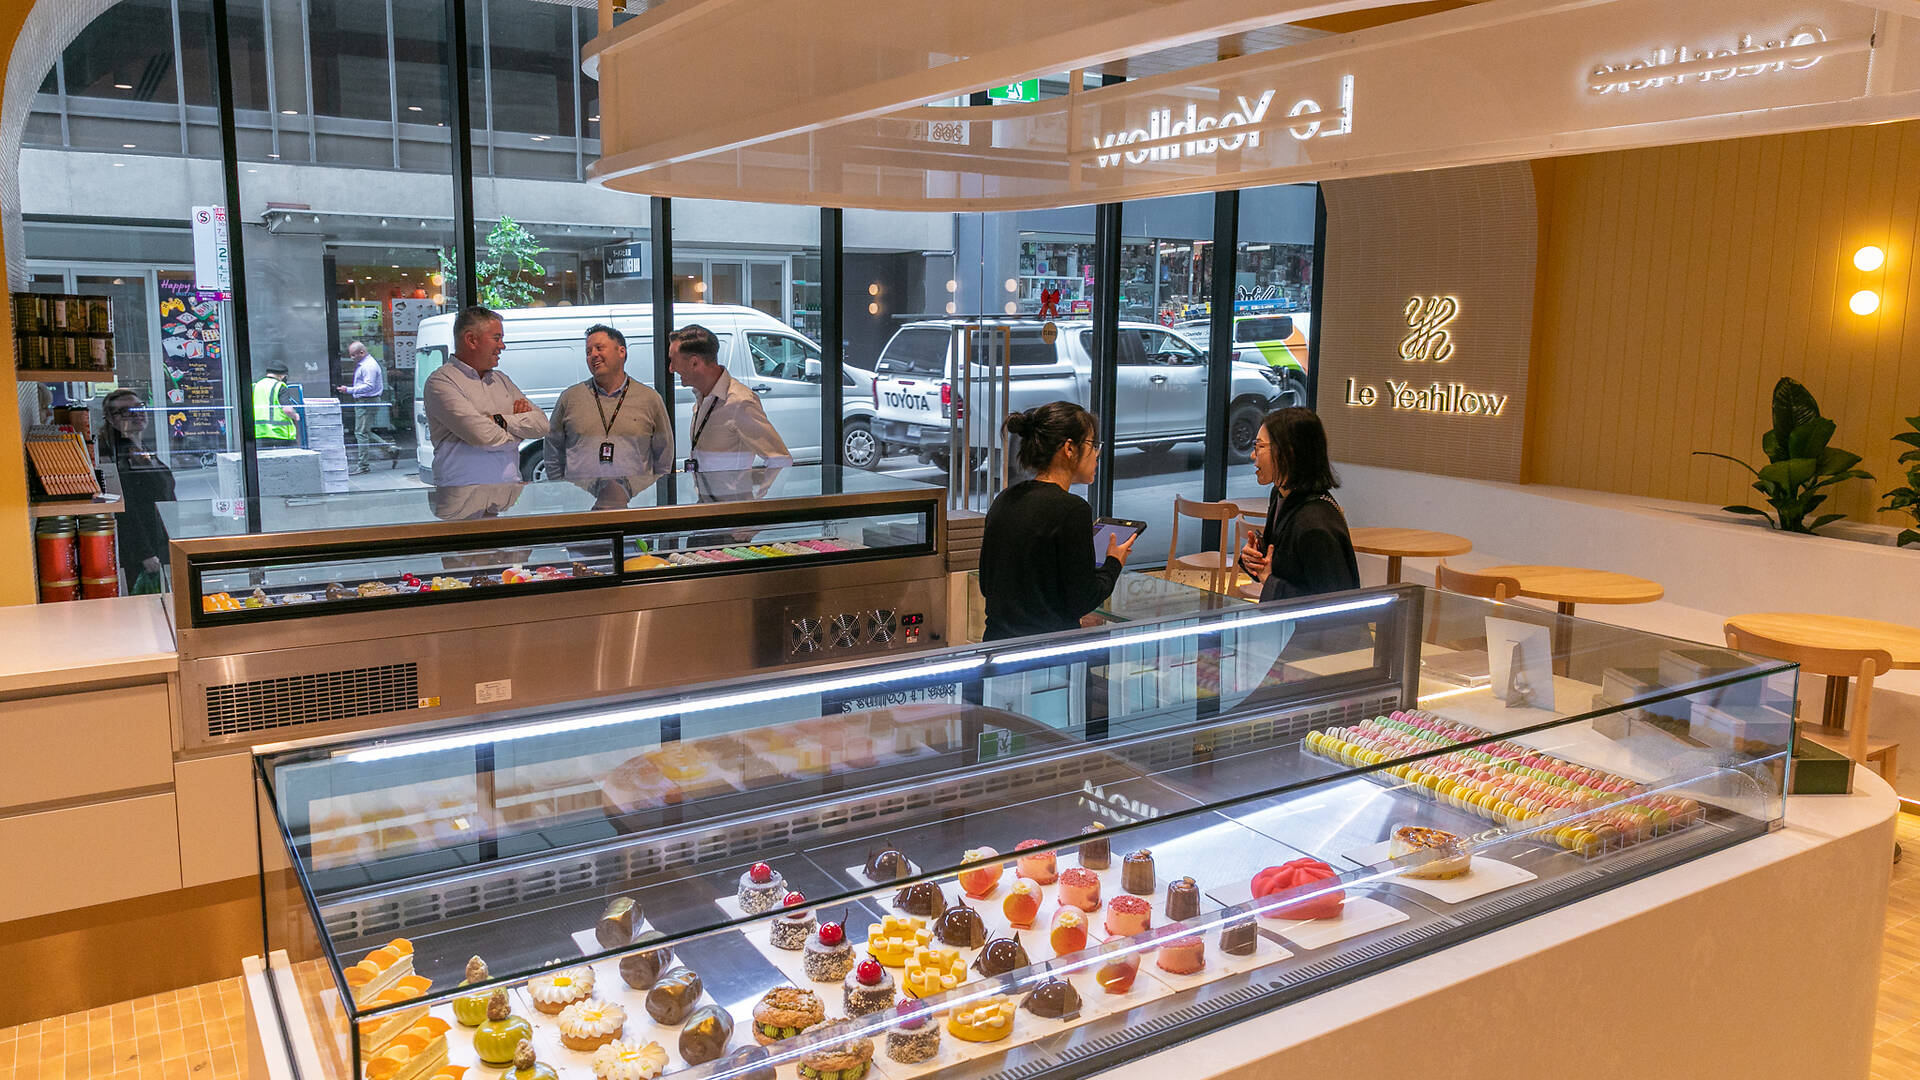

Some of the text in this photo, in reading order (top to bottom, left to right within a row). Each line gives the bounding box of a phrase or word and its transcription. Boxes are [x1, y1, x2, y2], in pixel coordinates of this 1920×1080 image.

[161, 279, 191, 294] Happy
[884, 391, 930, 411] TOYOTA
[1344, 377, 1508, 416] Le Yeahllow
